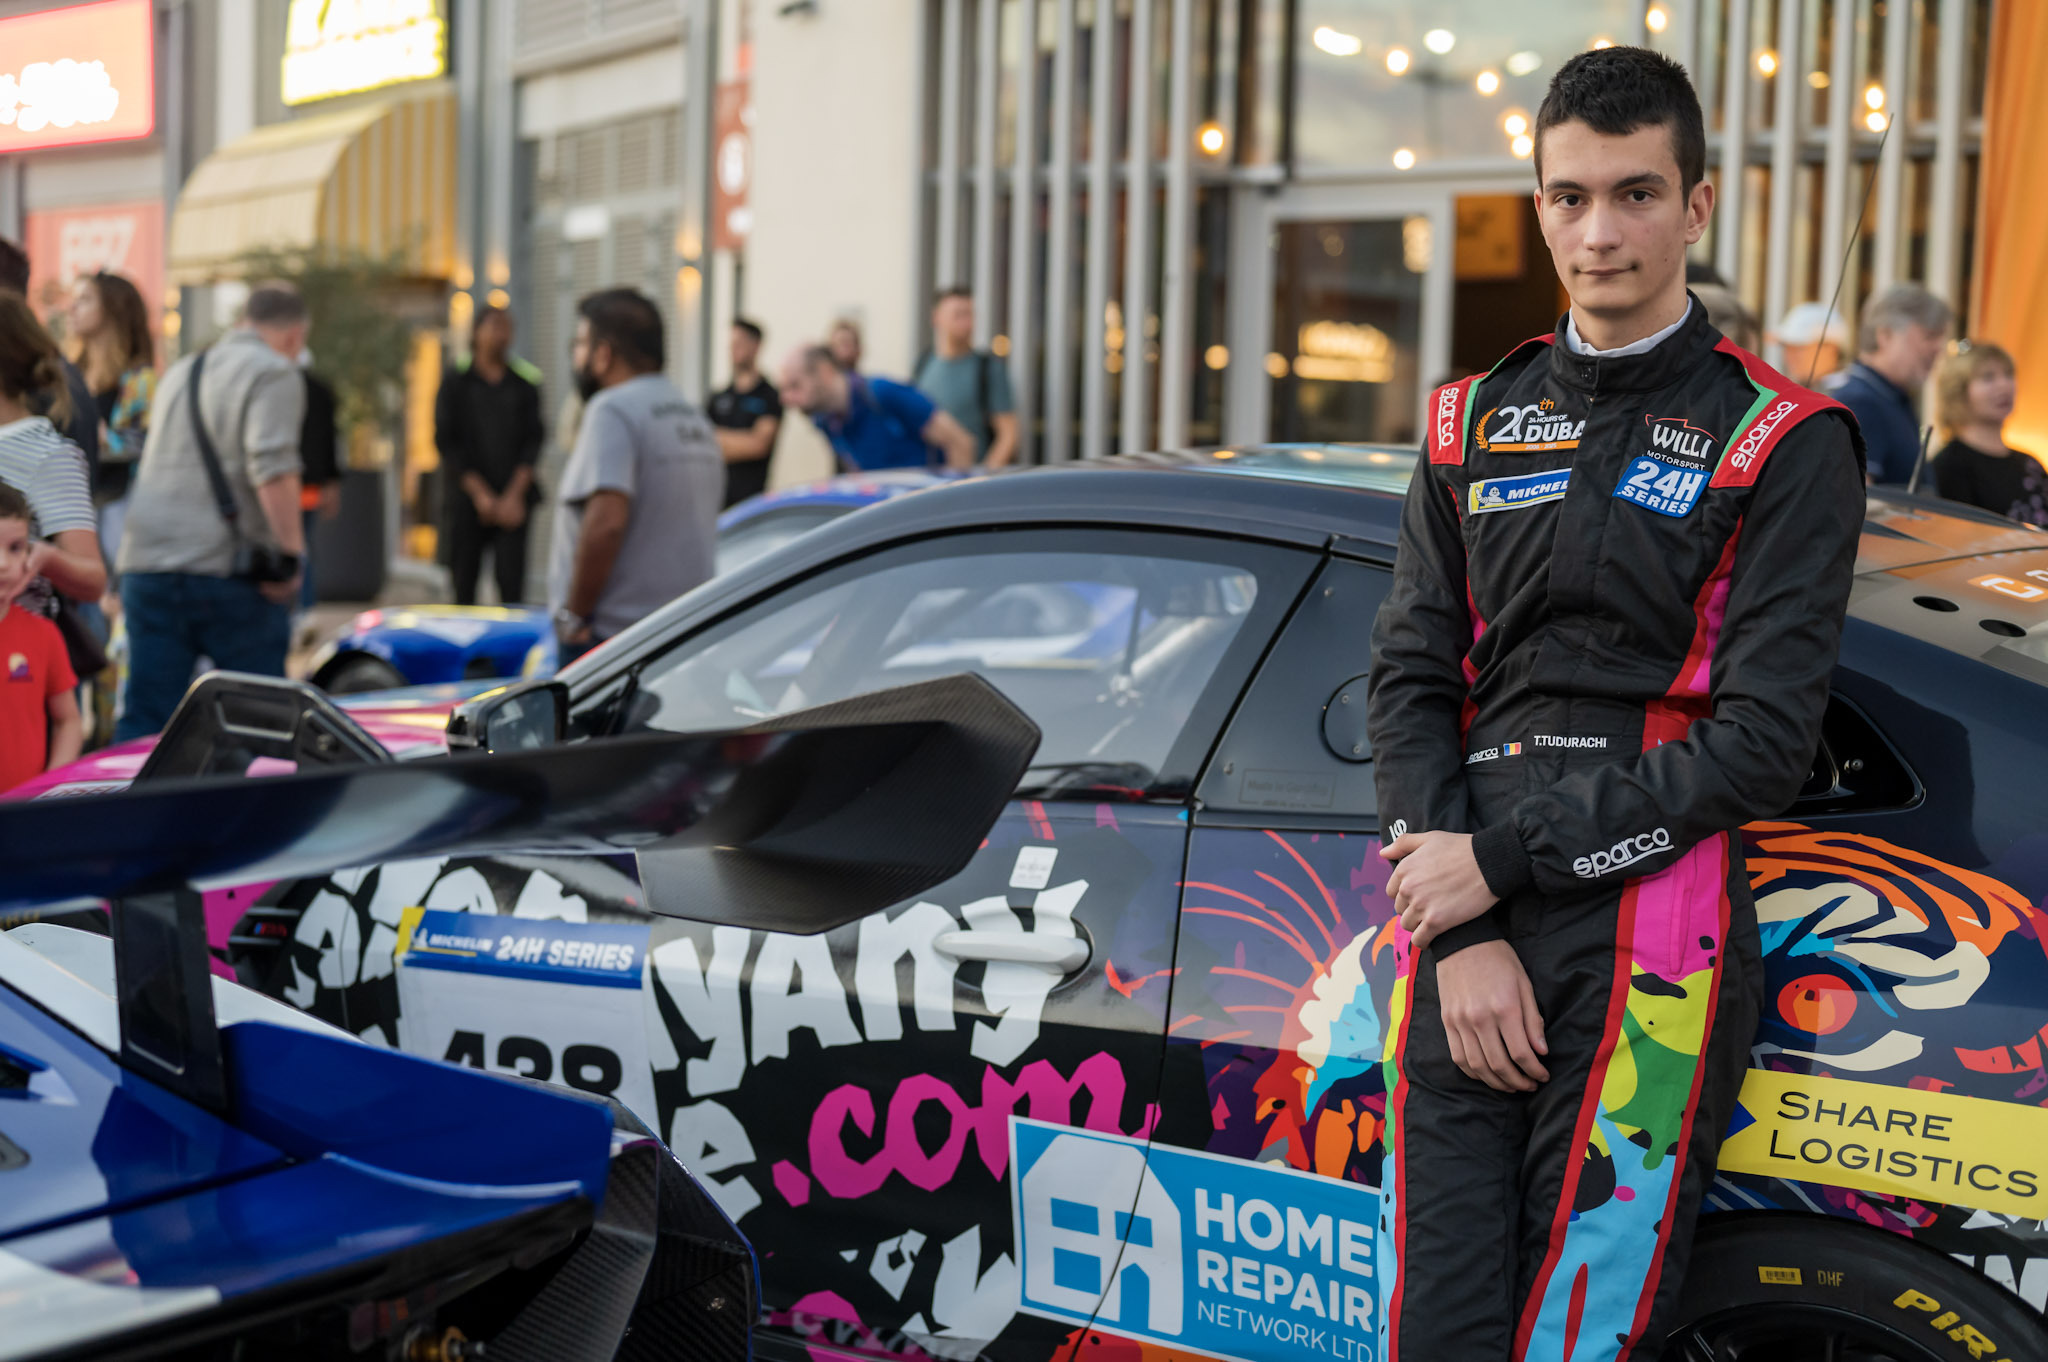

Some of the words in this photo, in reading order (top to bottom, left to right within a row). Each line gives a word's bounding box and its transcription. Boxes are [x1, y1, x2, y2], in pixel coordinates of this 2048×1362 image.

[1437, 386, 1460, 451] sparco
[1523, 420, 1586, 443] DUBA
[1537, 415, 1558, 423] HOURS
[1730, 401, 1799, 473] sparco
[1646, 450, 1706, 471] MOTORSPORT
[1652, 423, 1713, 460] WILLI
[1507, 480, 1569, 500] MICHEL
[1618, 485, 1690, 515] SERIES
[1627, 460, 1704, 504] 24H
[1464, 747, 1499, 765] sparco
[1534, 735, 1608, 748] T.TUDURACHI
[1572, 827, 1676, 879] sparco
[429, 933, 494, 952] MICHELIN
[495, 935, 546, 964] 24H
[547, 940, 635, 971] SERIES
[1776, 1090, 1953, 1142] SHARE
[1769, 1130, 2039, 1198] LOGISTICS
[1195, 1187, 1374, 1278] HOME
[1197, 1248, 1374, 1333] REPAIR
[1817, 1269, 1845, 1287] DHF
[1197, 1299, 1327, 1353] NETWORK
[1332, 1334, 1373, 1362] LTD
[1893, 1289, 2013, 1362] PIR
